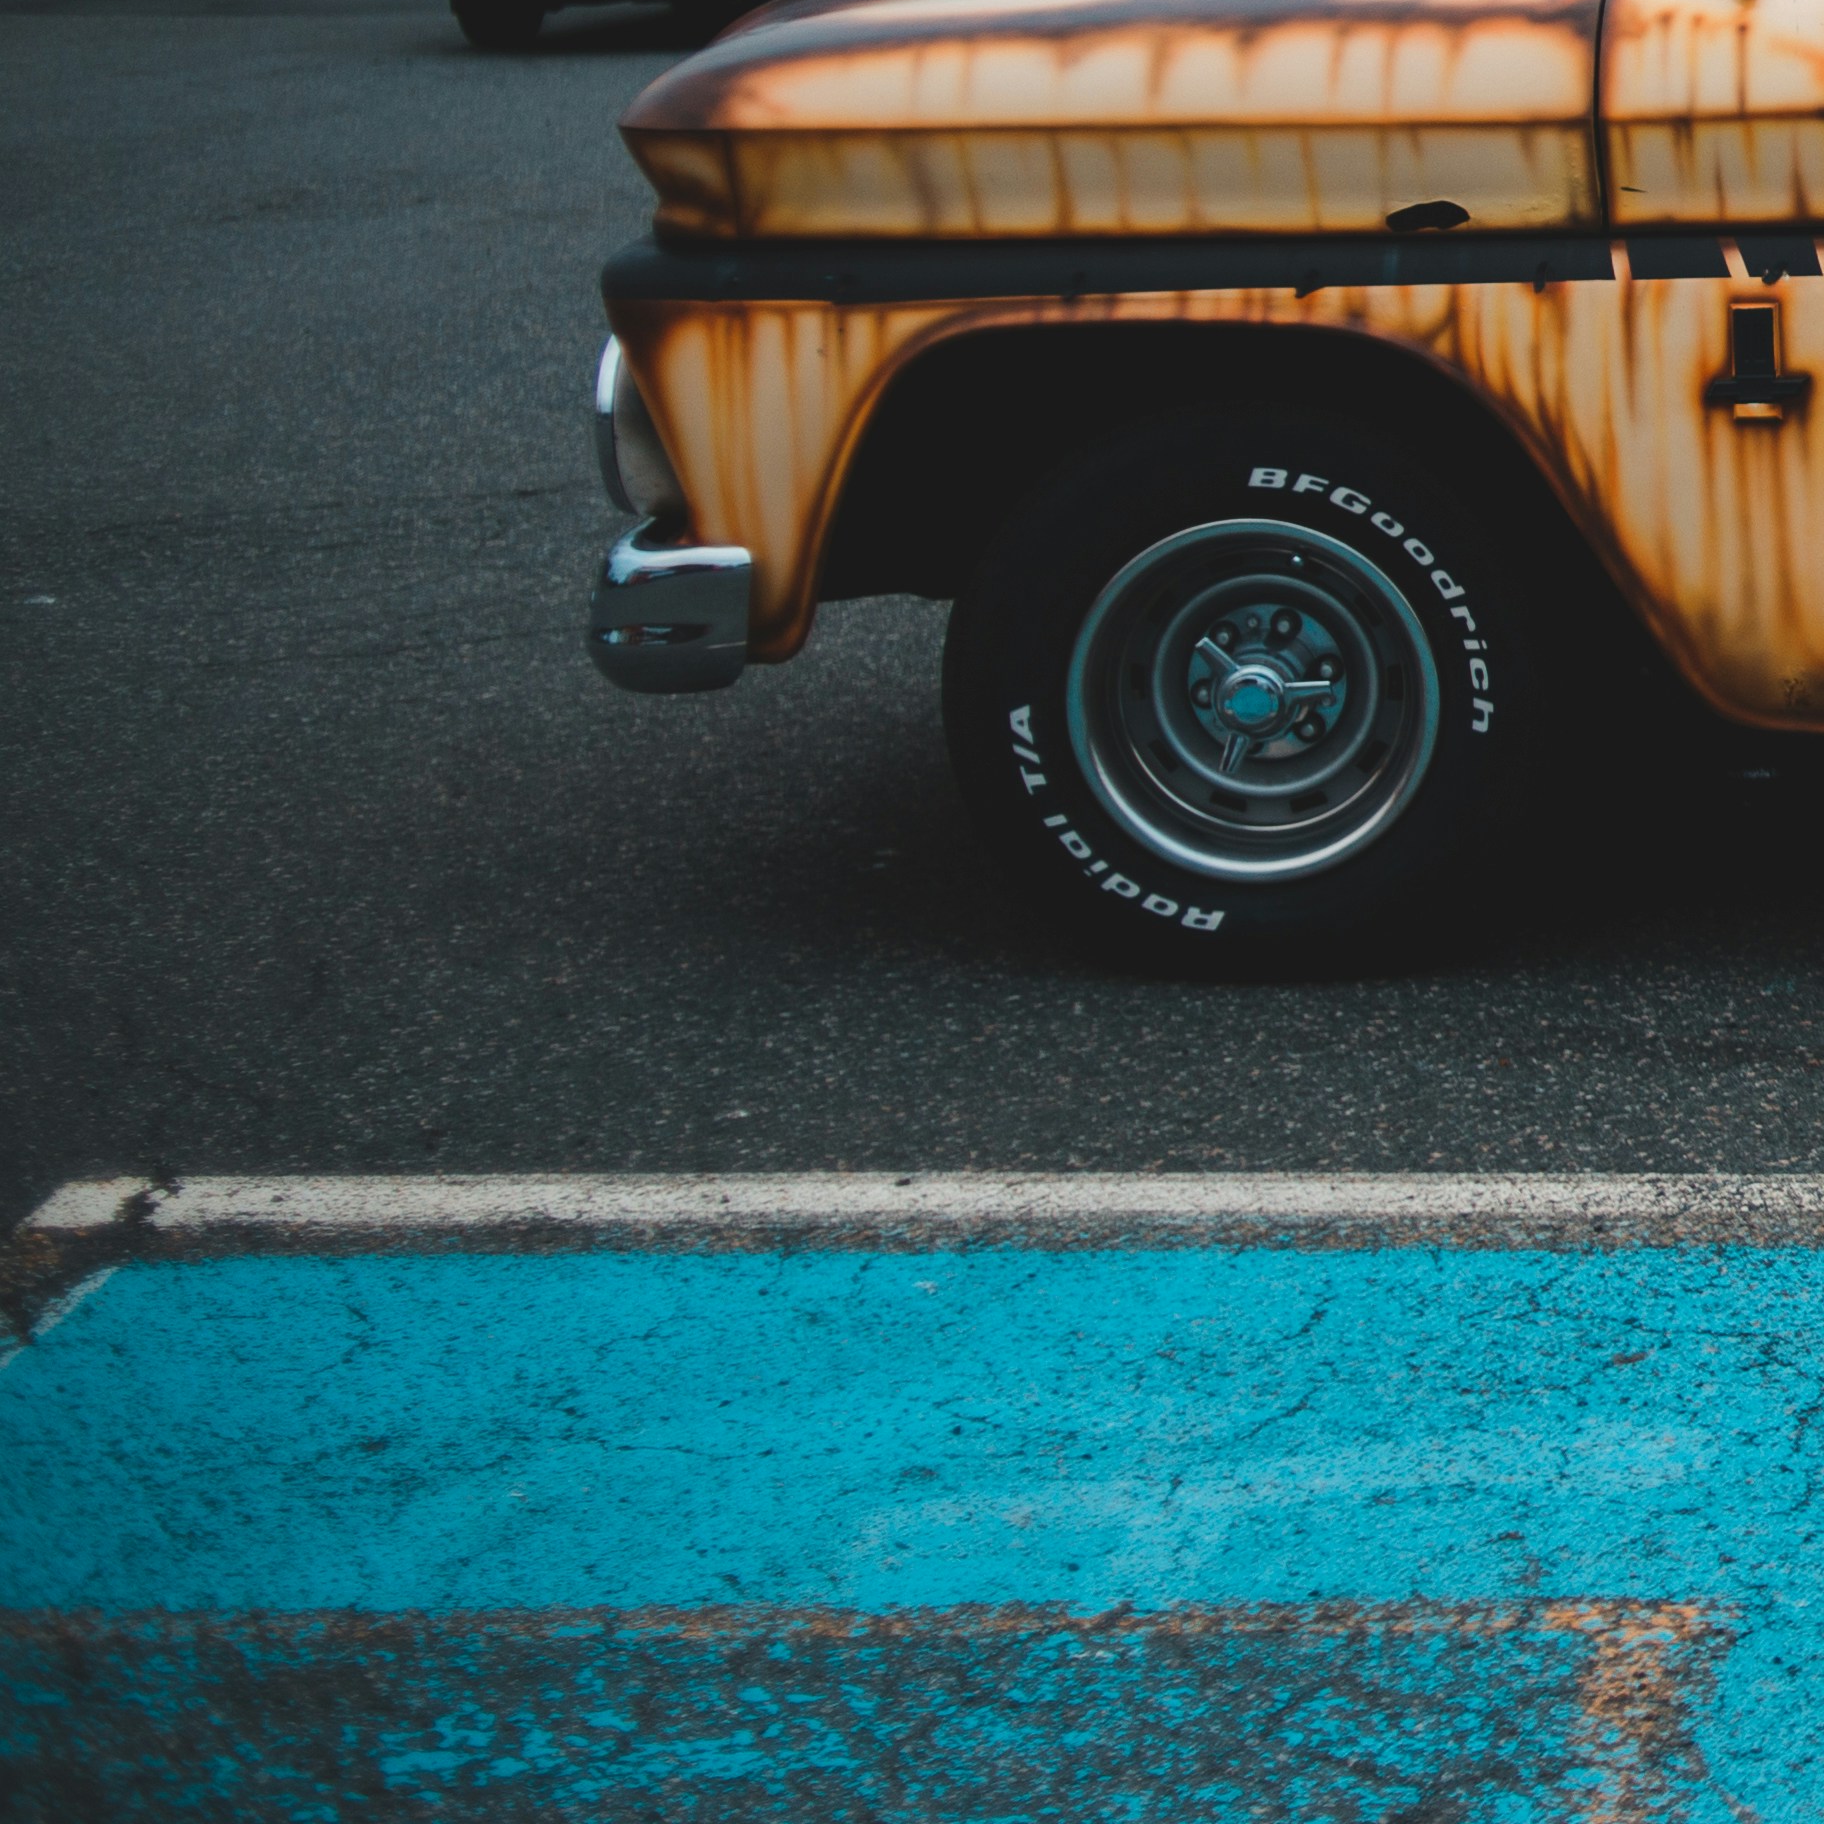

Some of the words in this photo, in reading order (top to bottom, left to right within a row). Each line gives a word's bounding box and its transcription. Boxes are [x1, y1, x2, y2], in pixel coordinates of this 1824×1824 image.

[1247, 466, 1494, 733] BFGoodrich
[1009, 703, 1048, 796] T/A
[1043, 814, 1227, 931] Radial
